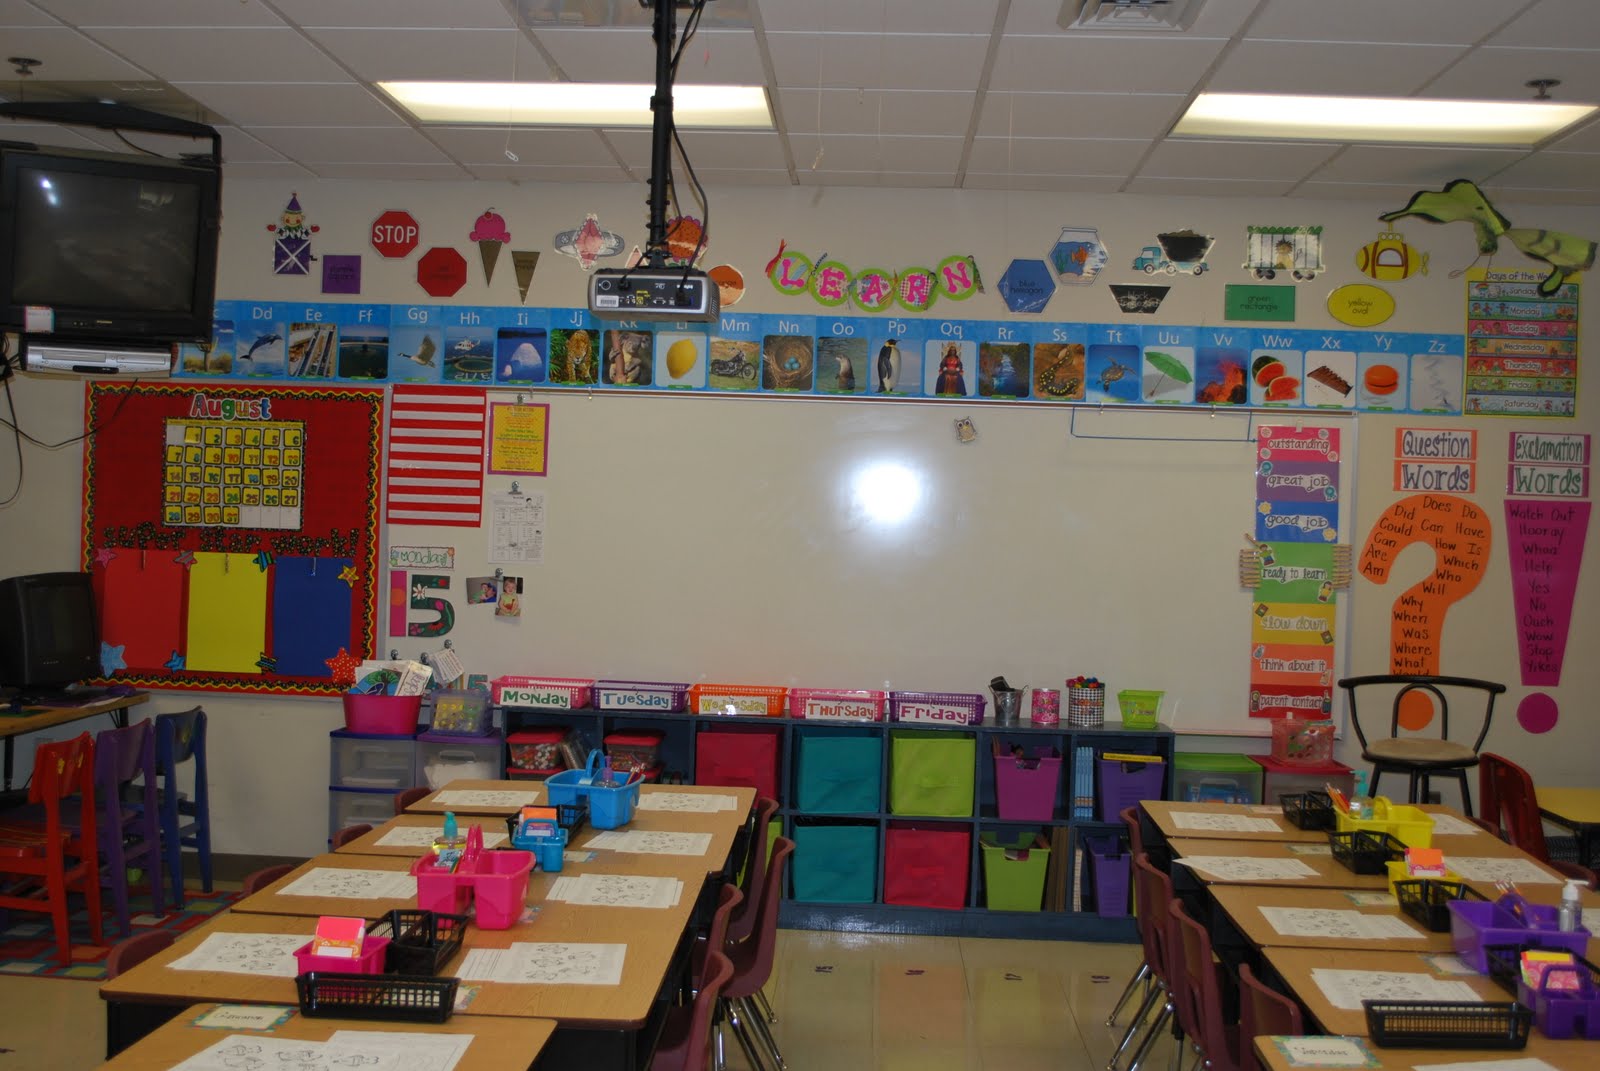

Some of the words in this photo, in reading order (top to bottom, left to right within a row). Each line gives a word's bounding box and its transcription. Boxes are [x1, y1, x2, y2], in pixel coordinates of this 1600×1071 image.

[374, 225, 417, 245] STOP
[780, 258, 972, 303] LEARN
[1486, 271, 1507, 281] Days
[1508, 271, 1519, 280] of
[1520, 272, 1535, 280] the
[1247, 295, 1271, 303] green
[1348, 298, 1373, 308] yellow
[1352, 306, 1369, 315] oval
[1510, 307, 1541, 316] Monday
[252, 306, 273, 320] Dd
[305, 308, 322, 321] Ee
[358, 309, 373, 322] Ff
[407, 308, 428, 324] Gg
[460, 312, 479, 325] Hh
[517, 312, 528, 325] Ii
[570, 311, 583, 327] Jj
[721, 319, 750, 332] Mm
[779, 321, 800, 334] Nn
[831, 323, 854, 336] Oo
[888, 321, 907, 337] Pp
[940, 323, 962, 340] Qq
[998, 327, 1014, 340] Rr
[1053, 329, 1067, 341] Ss
[1106, 330, 1122, 343] Tt
[1158, 332, 1180, 345] Uu
[1213, 334, 1233, 346] Vv
[1262, 336, 1292, 348] Ww
[1321, 336, 1341, 349] Xx
[1374, 335, 1393, 351] Yy
[1428, 341, 1446, 353] Zz
[1508, 323, 1539, 334] Tuesday
[1504, 343, 1545, 352] Wednesday
[1505, 360, 1541, 371] Thursday
[1508, 380, 1532, 390] Friday
[190, 393, 272, 421] August
[1504, 400, 1540, 410] Saturday
[195, 433, 199, 441] 1
[214, 434, 220, 444] 2
[235, 435, 240, 444] 3
[252, 435, 259, 444] 4
[272, 435, 278, 444] 5
[293, 436, 299, 445] 6
[1267, 437, 1330, 456] outstanding
[1402, 430, 1470, 458] Question
[1515, 434, 1583, 462] Exclamation
[175, 453, 181, 461] 7
[194, 453, 200, 462] 8
[213, 453, 220, 463] 9
[228, 454, 239, 463] 10
[249, 454, 259, 463] 11
[268, 455, 279, 464] 12
[288, 455, 298, 464] 13
[171, 472, 181, 481] 14
[189, 472, 200, 481] 15
[208, 472, 219, 482] 16
[228, 473, 240, 482] 17
[248, 474, 259, 483] 18
[266, 475, 278, 484] 19
[284, 476, 297, 485] 20
[1268, 476, 1302, 489] great
[1308, 476, 1330, 492] job
[1402, 463, 1470, 491] Words
[1515, 467, 1582, 495] Words
[170, 491, 180, 501] 21
[187, 492, 199, 502] 22
[207, 492, 219, 502] 23
[227, 493, 239, 503] 24
[245, 494, 258, 503] 25
[265, 495, 277, 504] 26
[284, 495, 296, 504] 27
[1423, 496, 1452, 513] Does
[168, 511, 180, 521] 28
[187, 512, 200, 521] 29
[207, 512, 219, 522] 30
[227, 513, 237, 522] 31
[1394, 505, 1415, 520] Did
[1462, 504, 1477, 520] Do
[1510, 504, 1543, 520] Watch
[1551, 507, 1576, 521] Out
[1265, 514, 1299, 530] good
[1305, 514, 1329, 531] job
[1379, 517, 1413, 536] Could
[1420, 519, 1444, 534] Can
[1455, 522, 1485, 539] Have
[1374, 532, 1397, 548] Can
[1519, 523, 1565, 546] Hooray
[1365, 546, 1388, 562] Are
[1435, 537, 1456, 551] How
[1467, 542, 1482, 556] Is
[1363, 562, 1384, 577] Am
[1443, 554, 1479, 571] Which
[1525, 559, 1552, 576] Help
[1262, 567, 1287, 584] ready
[1290, 568, 1298, 579] to
[1303, 567, 1327, 580] learn
[1435, 569, 1461, 583] Who
[1422, 582, 1446, 596] Will
[1528, 579, 1551, 594] Yes
[390, 570, 455, 638] 15
[1401, 596, 1424, 612] Why
[1530, 598, 1547, 611] No
[1262, 615, 1290, 629] slow
[1295, 614, 1327, 630] down
[1394, 610, 1428, 625] When
[1523, 615, 1554, 628] Ouch
[1402, 627, 1430, 640] Was
[1525, 632, 1553, 642] Wow
[1394, 643, 1433, 656] Where
[1526, 644, 1553, 662] Stop
[1260, 659, 1284, 672] think
[1287, 659, 1315, 671] about
[1318, 660, 1326, 672] it
[1394, 656, 1424, 668] What
[1525, 659, 1559, 673] Yikes
[701, 697, 767, 714] Wedesday
[1260, 695, 1288, 710] parent
[1291, 694, 1323, 708] contact
[901, 704, 968, 724] Friday
